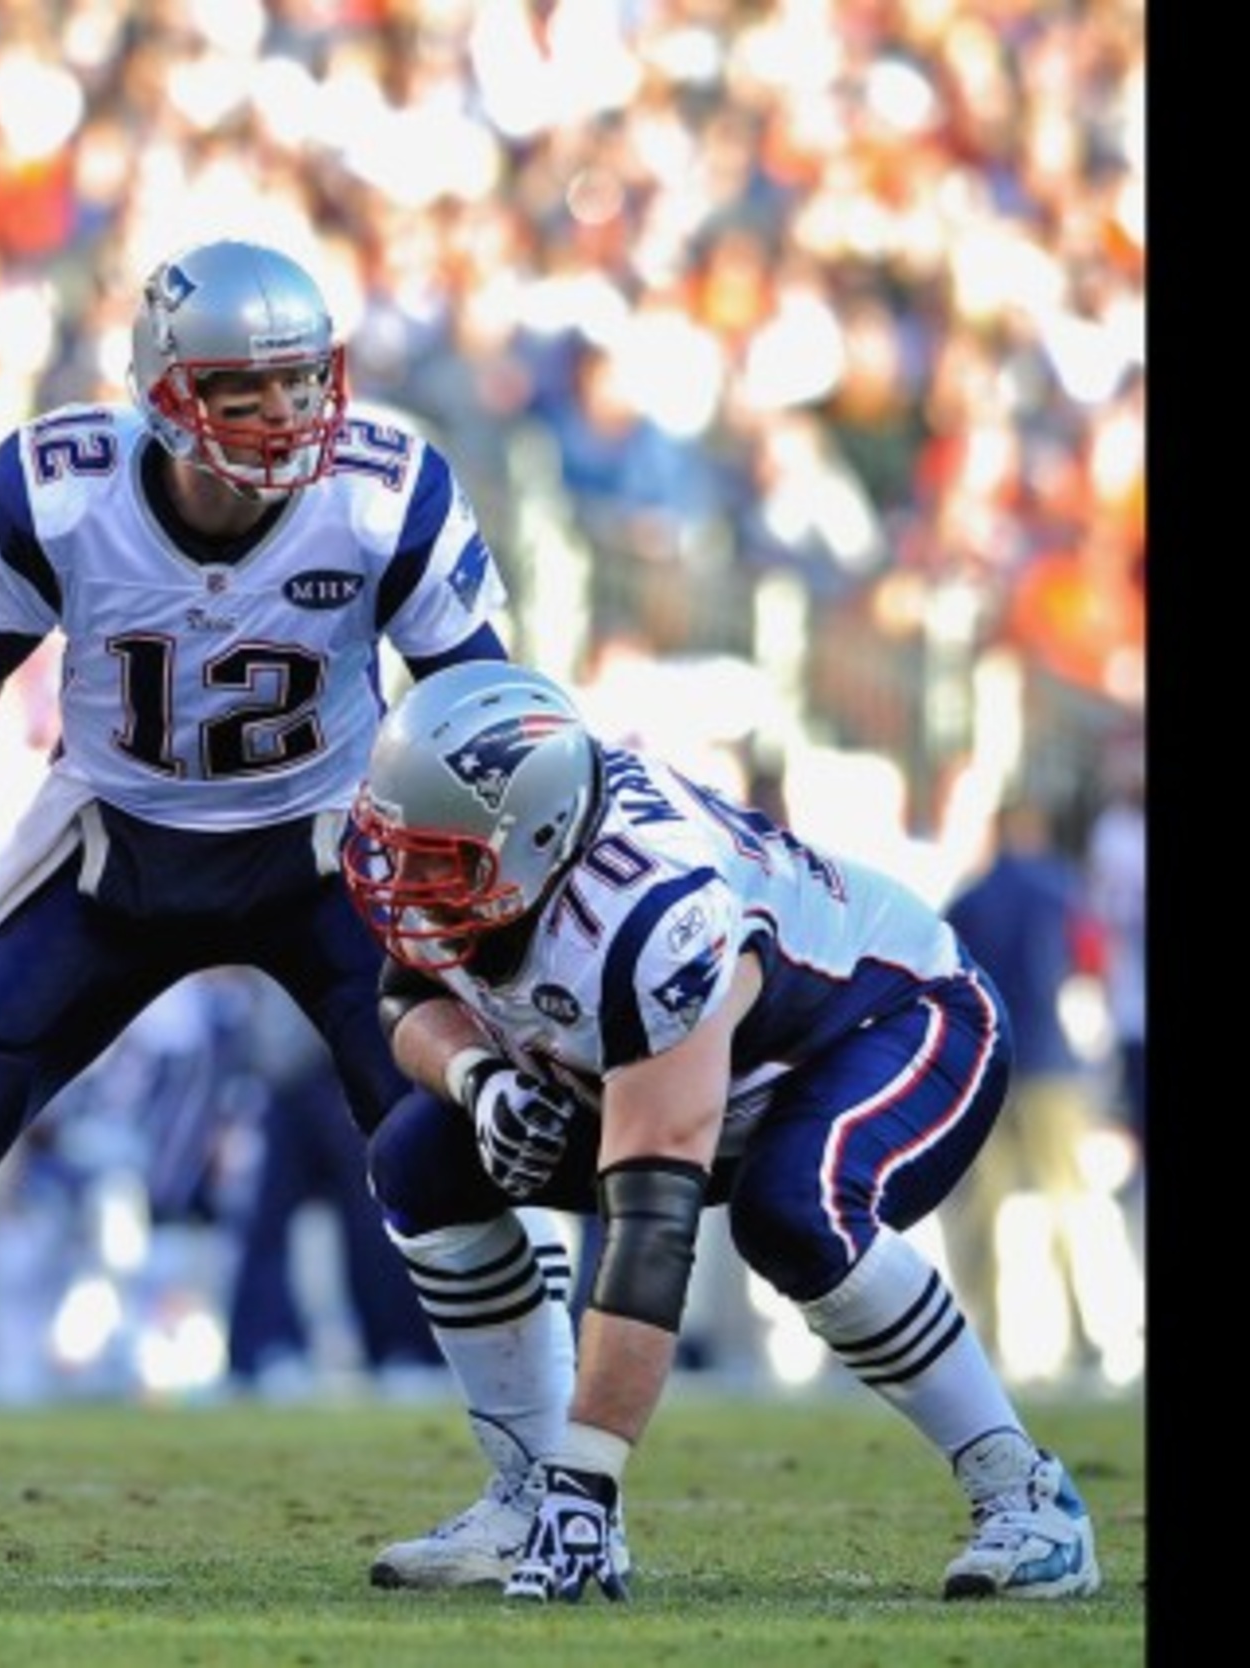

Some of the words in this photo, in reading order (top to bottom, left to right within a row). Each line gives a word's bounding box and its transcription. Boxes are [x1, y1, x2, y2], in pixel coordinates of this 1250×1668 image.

[32, 407, 118, 486] 12
[330, 418, 414, 493] 12
[106, 630, 329, 781] 12
[546, 832, 661, 950] 70
